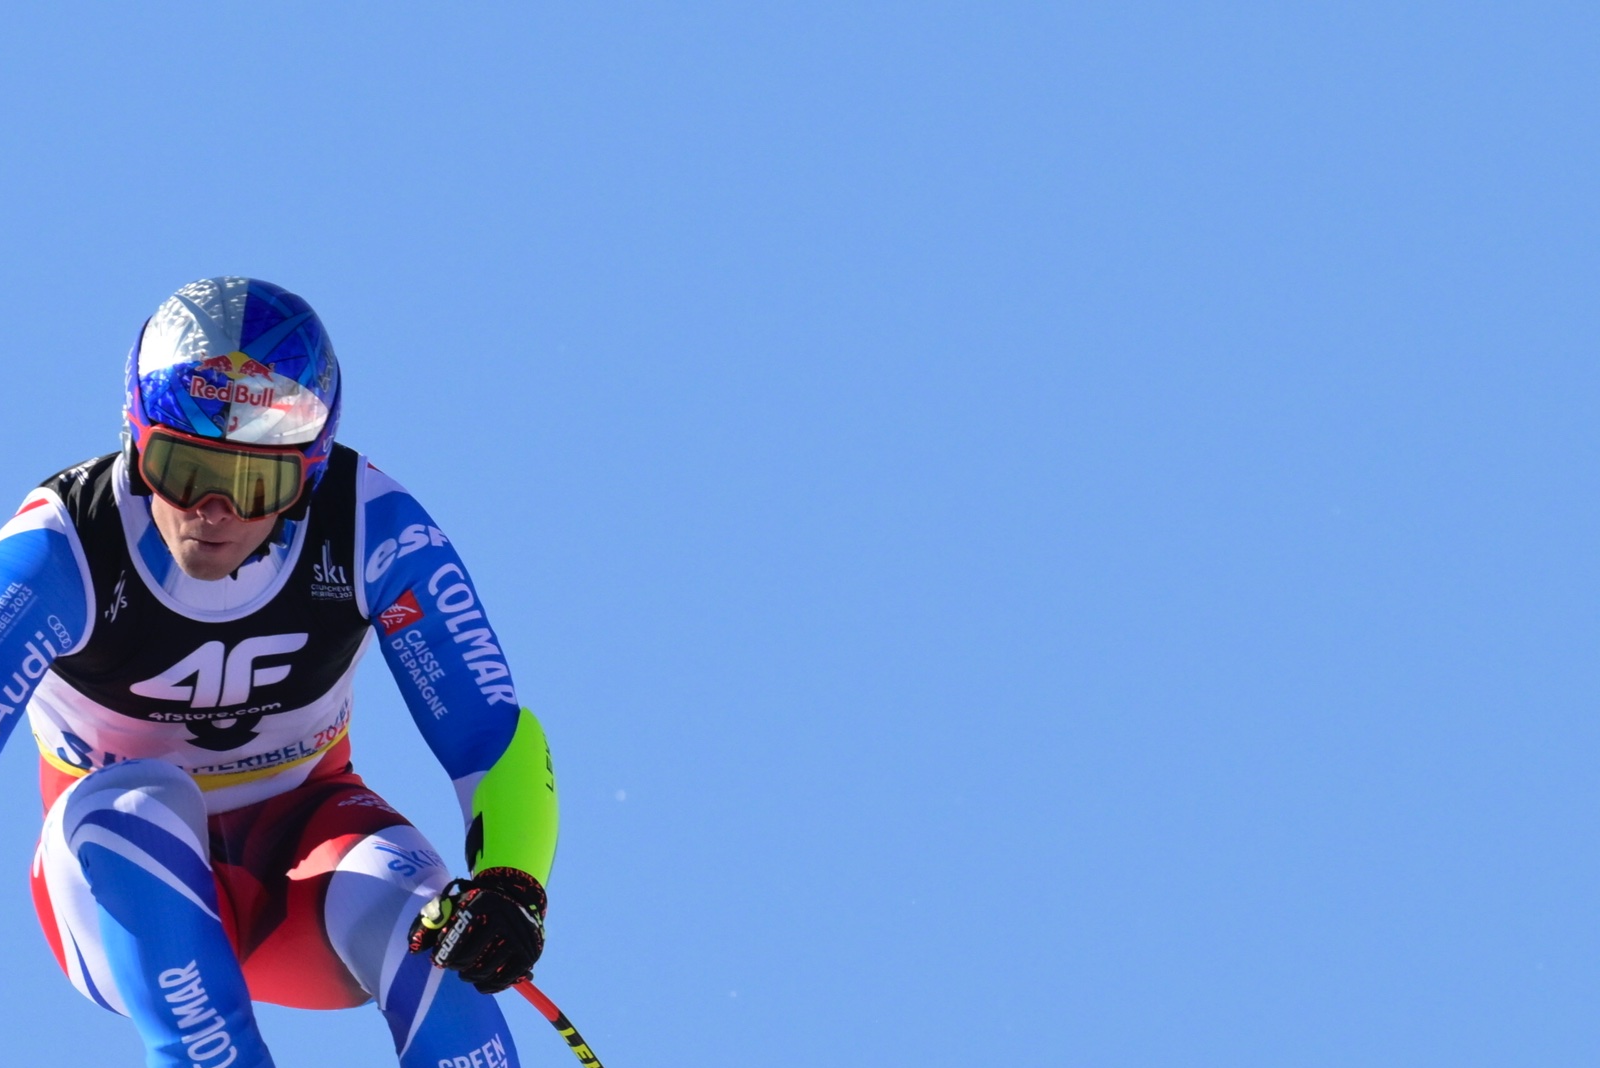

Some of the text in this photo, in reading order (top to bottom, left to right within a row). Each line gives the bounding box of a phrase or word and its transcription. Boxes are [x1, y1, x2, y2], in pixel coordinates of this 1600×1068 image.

[190, 375, 275, 408] Red Bull
[405, 629, 445, 682] CAISSE
[427, 563, 518, 706] COLMAR
[130, 633, 309, 709] 4F
[434, 909, 473, 966] reusch
